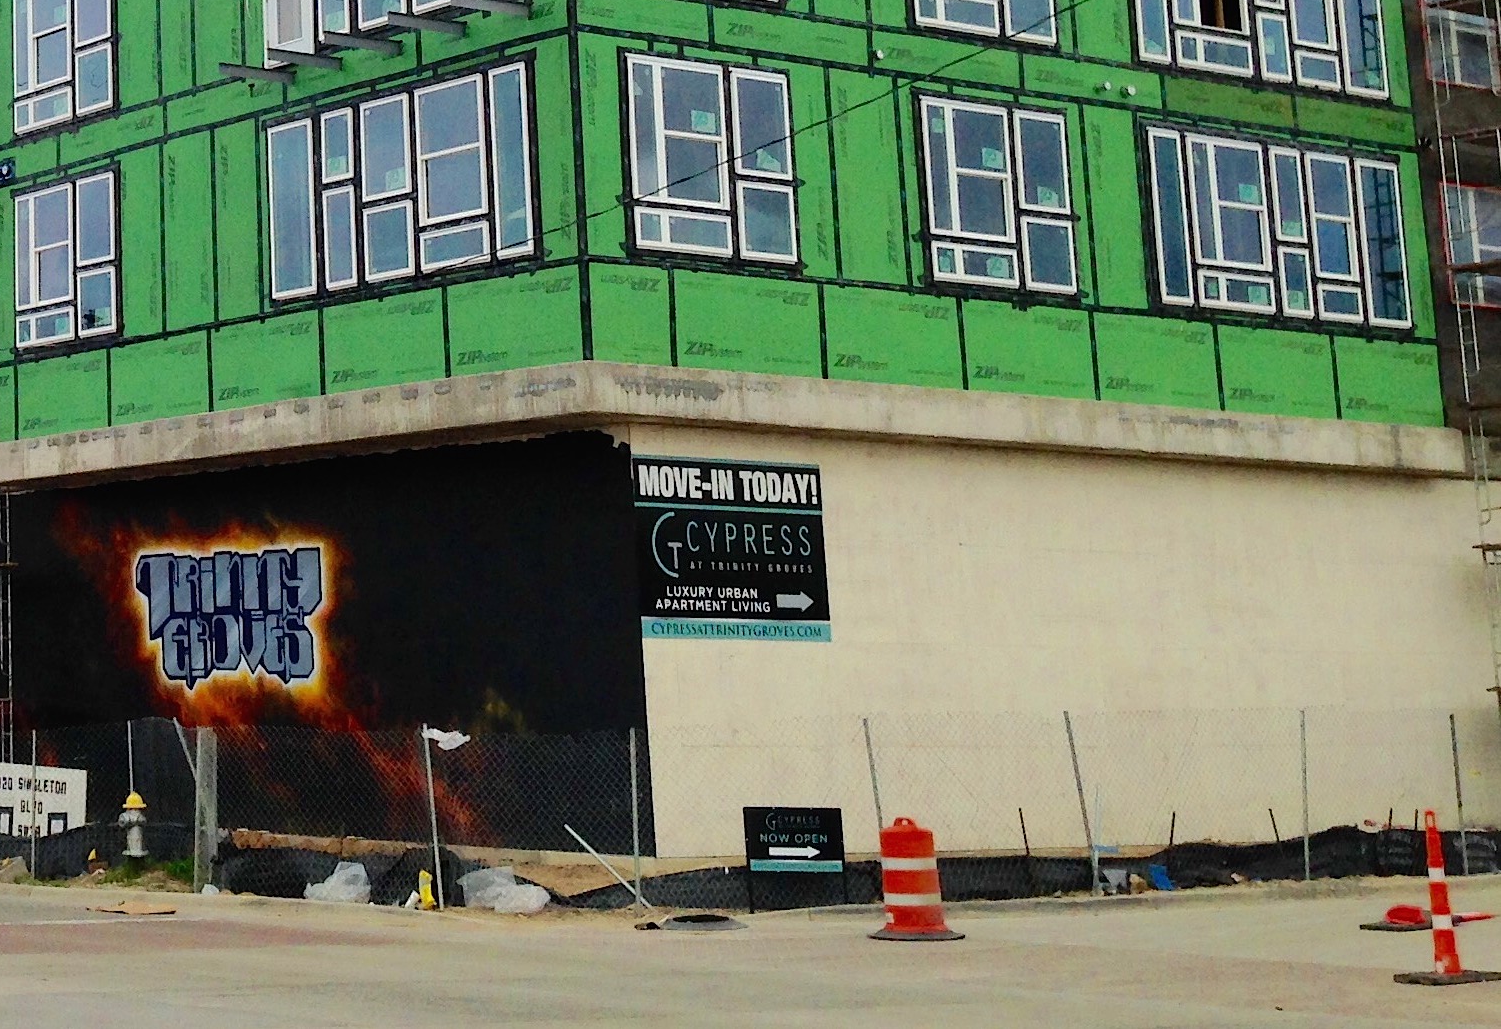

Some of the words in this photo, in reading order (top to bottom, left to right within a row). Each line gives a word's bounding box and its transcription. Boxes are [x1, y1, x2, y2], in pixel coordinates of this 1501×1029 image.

[638, 465, 735, 501] MOVE-IN
[739, 470, 819, 505] TODAY!
[686, 520, 811, 556] CYPRESS
[690, 560, 703, 570] AT
[711, 561, 760, 572] TRINITY
[768, 564, 813, 574] GROVES
[666, 585, 714, 598] LUXURY
[717, 587, 758, 599] URBAN
[655, 598, 728, 612] APARTMENT
[731, 600, 771, 613] LIVING
[759, 833, 790, 844] NOW
[794, 833, 828, 844] OPEN
